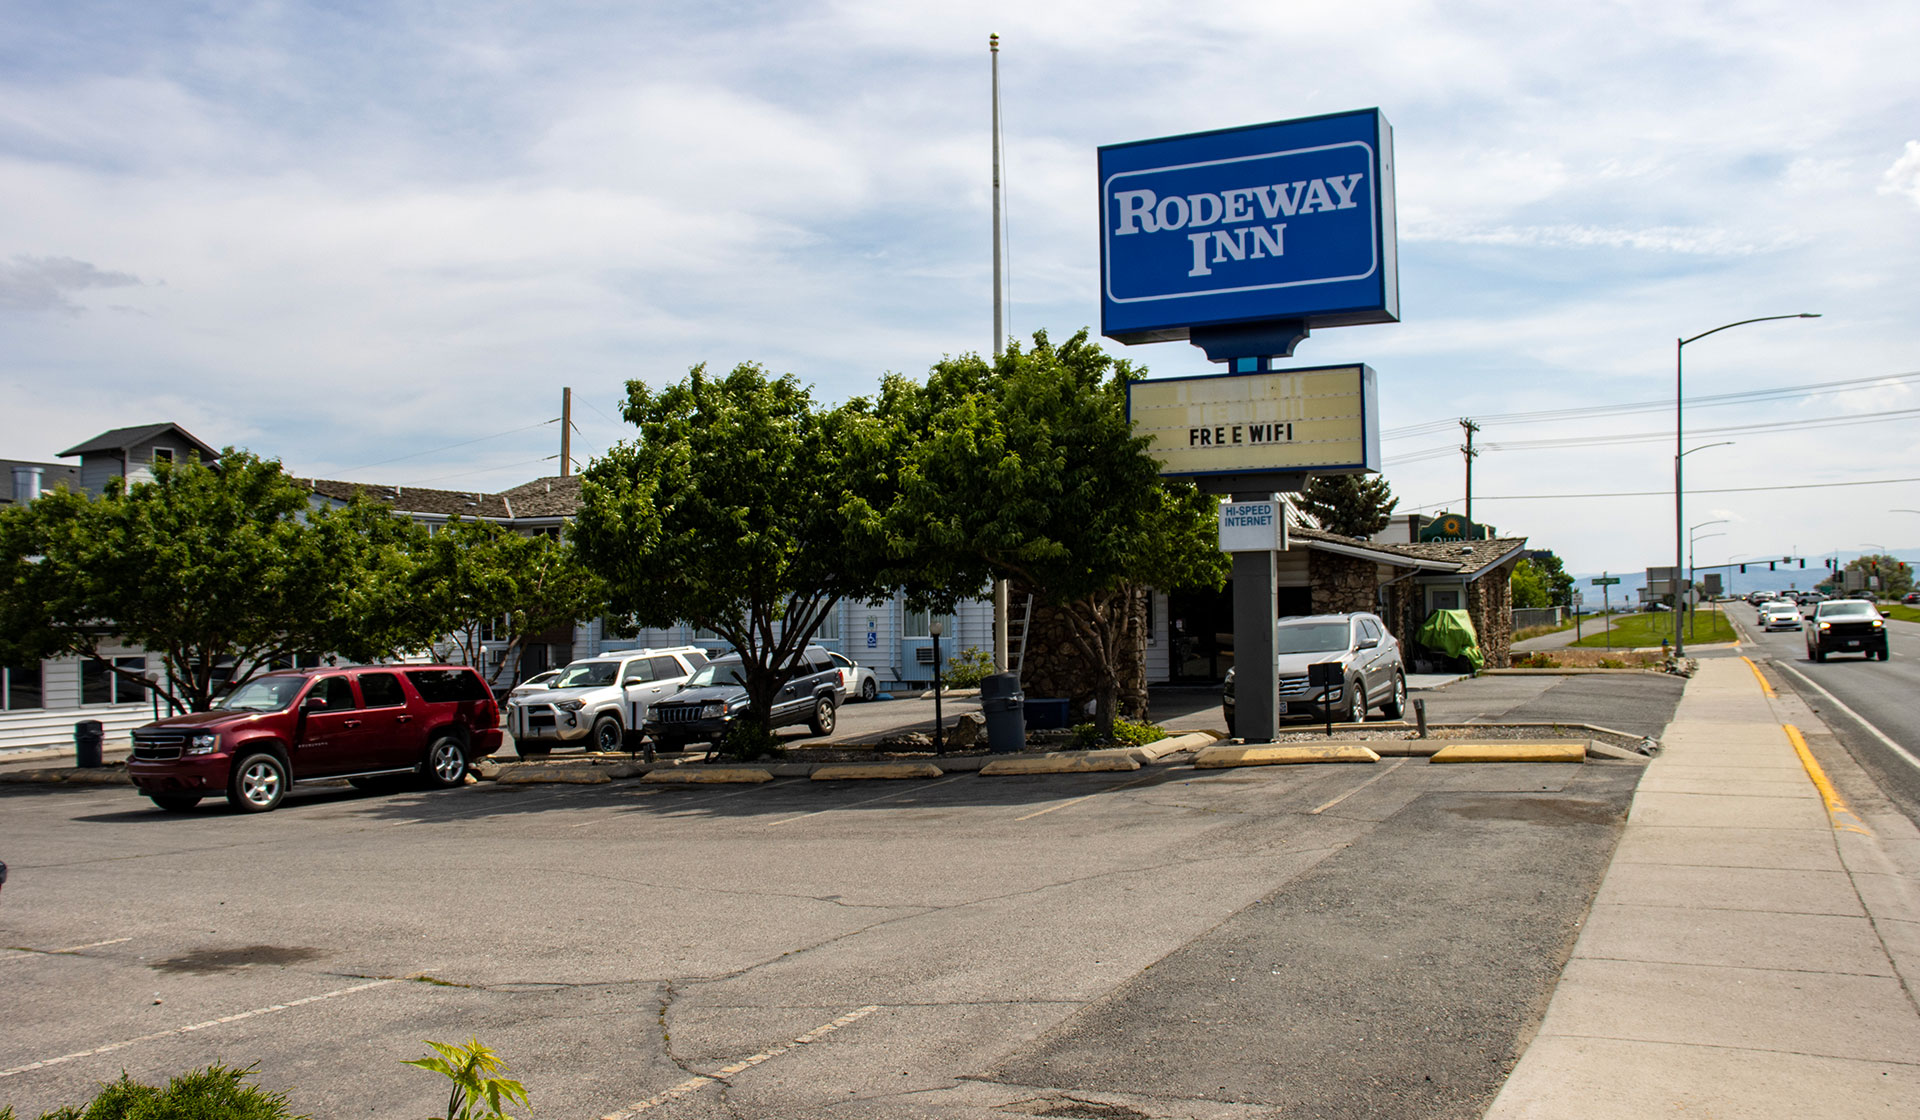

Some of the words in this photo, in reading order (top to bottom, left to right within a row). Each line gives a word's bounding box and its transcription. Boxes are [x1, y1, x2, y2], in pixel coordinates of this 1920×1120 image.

[1114, 173, 1363, 236] RODEWAY
[1188, 223, 1287, 277] INN
[1189, 426, 1243, 446] FREE
[1249, 423, 1293, 443] WIFI
[1224, 515, 1273, 527] INTERNET
[1225, 504, 1272, 517] HI-SPEED
